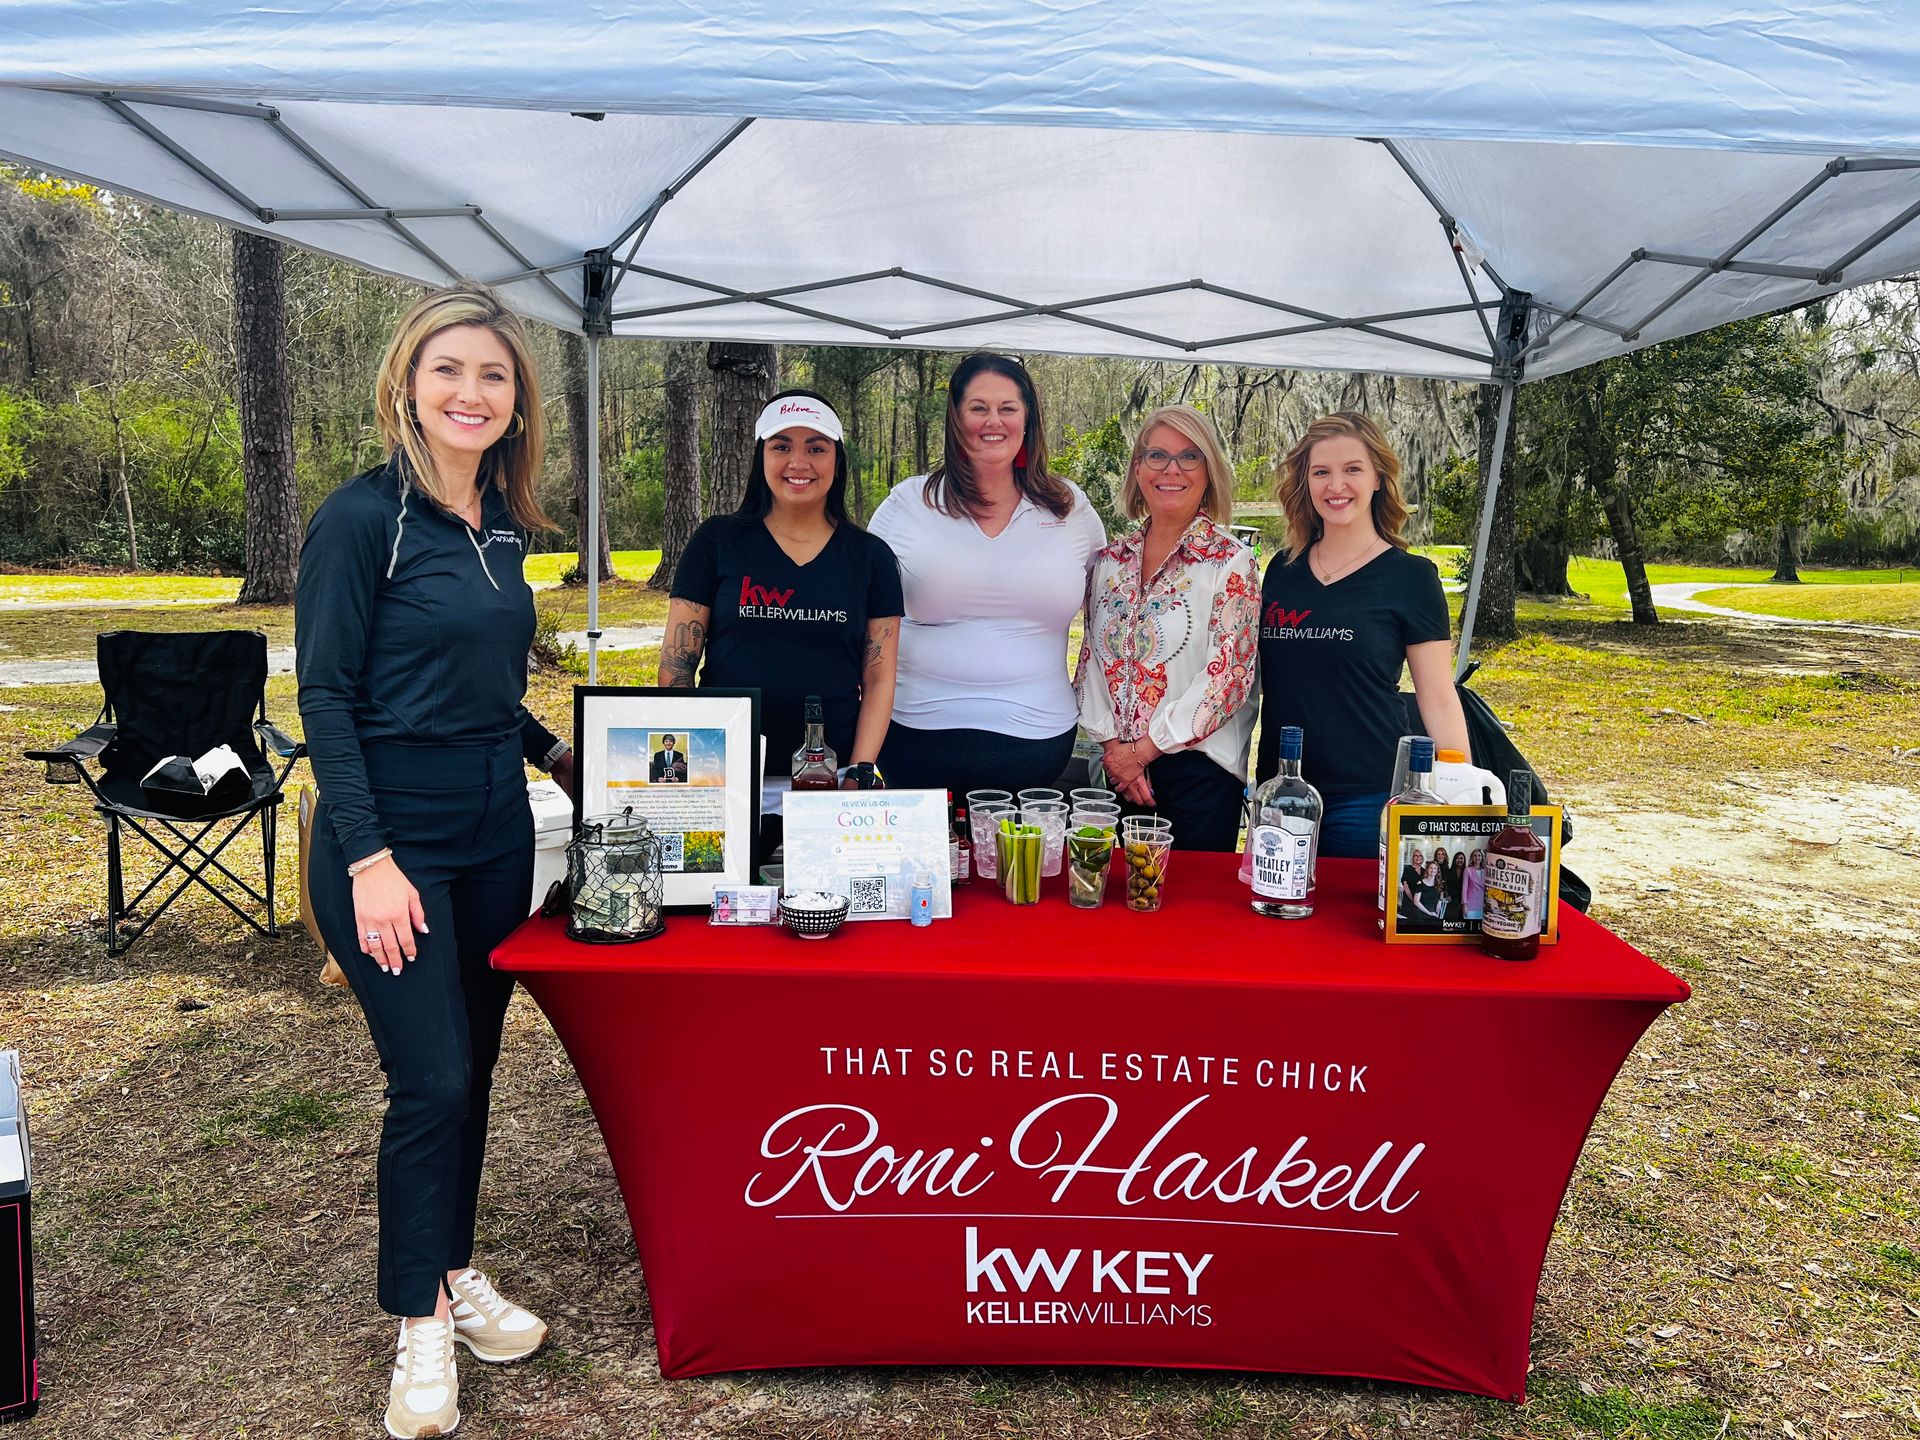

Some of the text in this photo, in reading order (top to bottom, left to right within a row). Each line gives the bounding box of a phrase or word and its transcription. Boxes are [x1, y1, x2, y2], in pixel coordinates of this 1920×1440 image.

[780, 402, 820, 415] Believe
[739, 575, 795, 608] kw
[739, 605, 848, 622] KELLERWILLIAMS
[1429, 821, 1449, 832] THAT
[1450, 822, 1460, 832] SC
[1461, 822, 1480, 833] REAL
[1481, 822, 1506, 833] ESTAT
[1256, 855, 1290, 872] WHEATLEY
[1492, 881, 1507, 890] MIX
[820, 1047, 1368, 1093] THAT SC REAL ESTATE CHICK
[745, 1093, 1426, 1214] Roni Haskell
[965, 1226, 1214, 1296] kw KEY
[966, 1301, 1213, 1327] KELLERWILLIAMS
